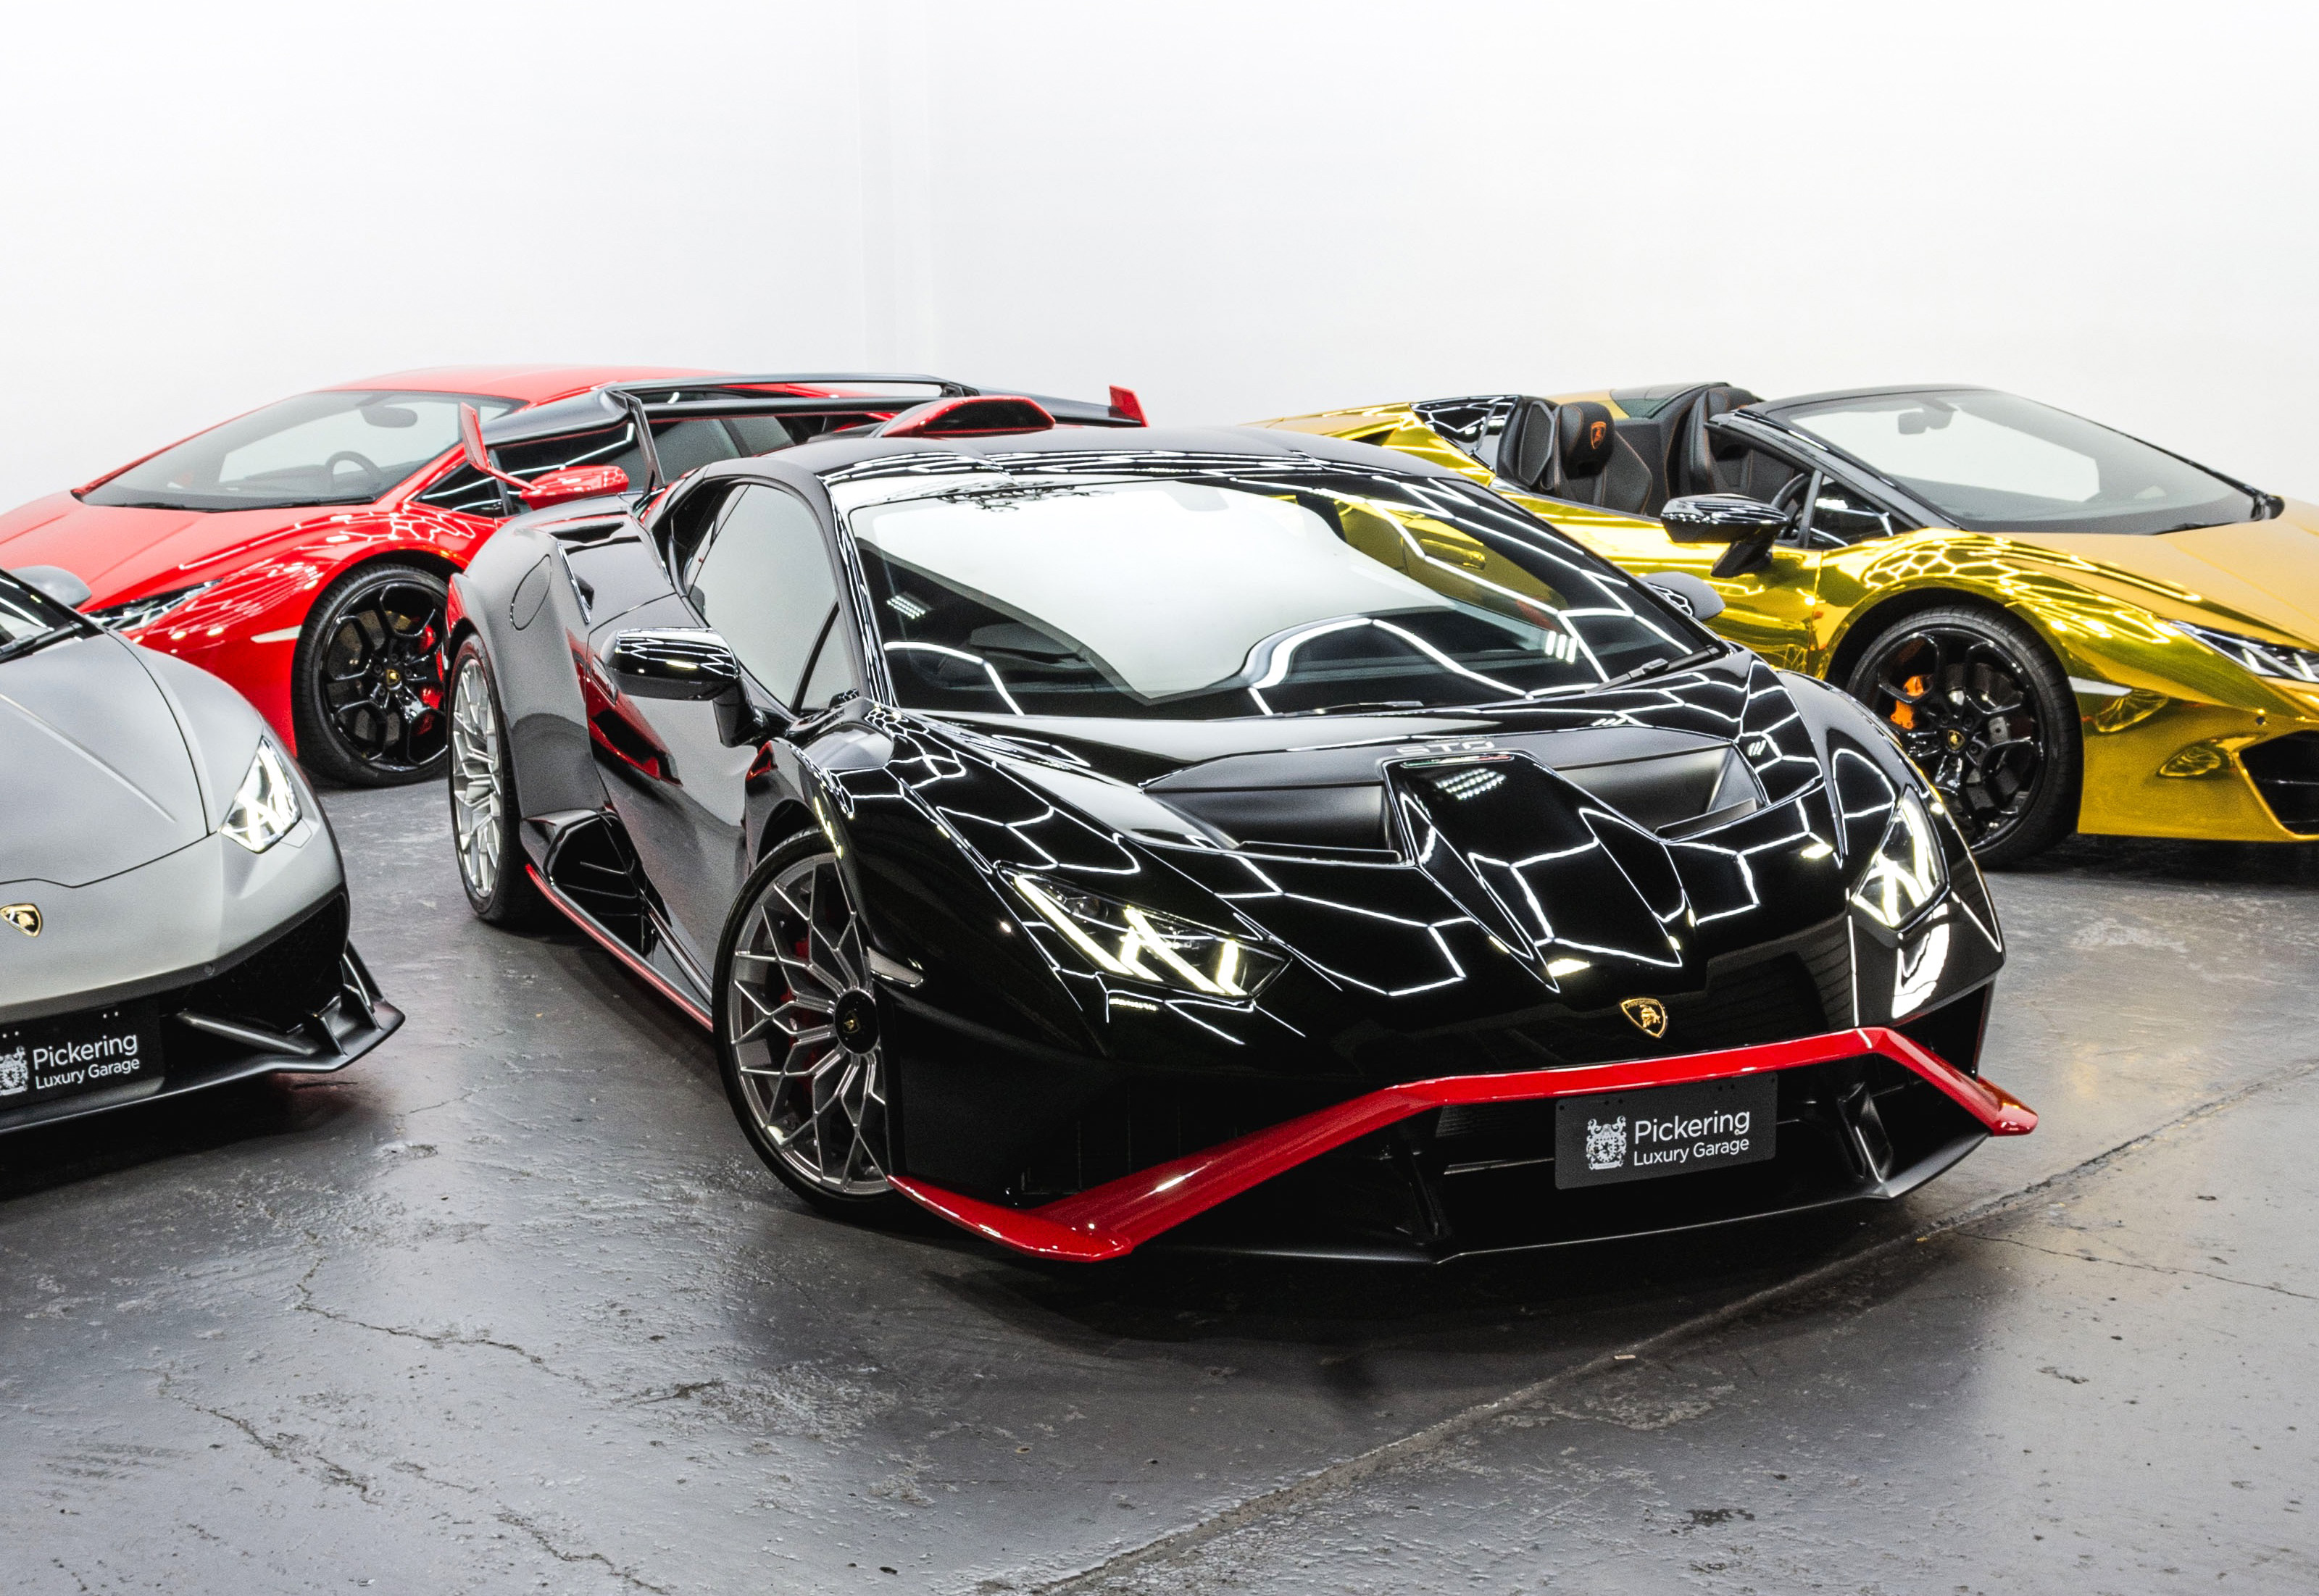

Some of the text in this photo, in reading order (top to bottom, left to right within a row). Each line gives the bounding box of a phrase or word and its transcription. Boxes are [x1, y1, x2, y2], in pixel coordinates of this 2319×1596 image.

[1396, 740, 1495, 756] STO
[33, 1034, 138, 1071] Pickering
[35, 1058, 141, 1090] Luxury Garage
[1634, 1110, 1750, 1145] Pickering
[1633, 1138, 1750, 1166] Luxury Garage
